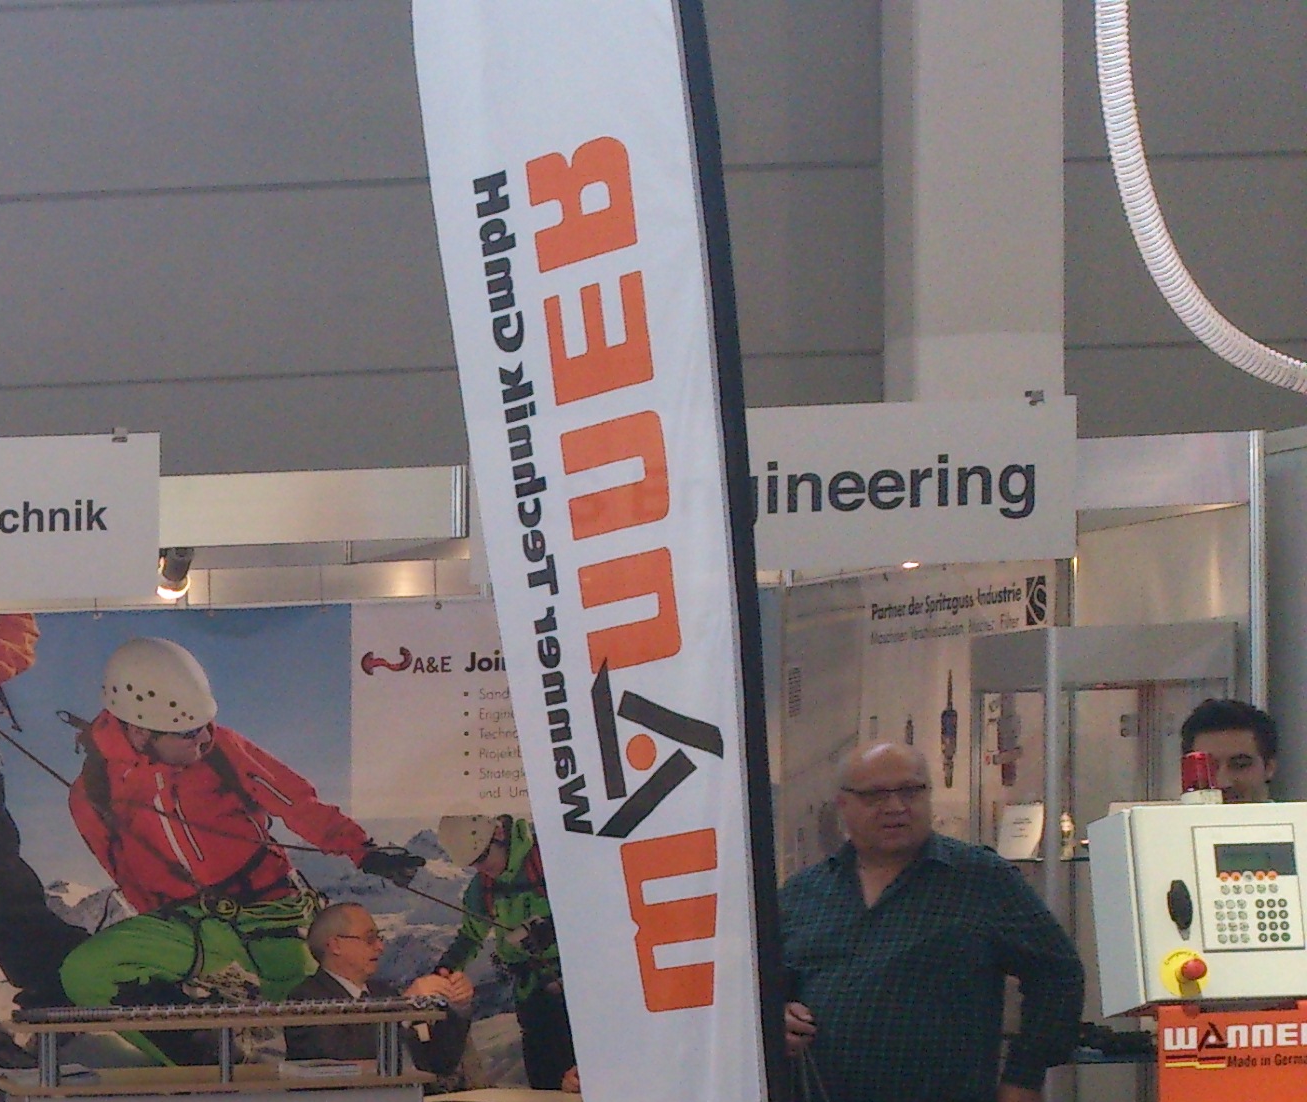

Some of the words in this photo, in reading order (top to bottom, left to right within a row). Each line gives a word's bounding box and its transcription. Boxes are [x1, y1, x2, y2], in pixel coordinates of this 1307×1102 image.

[749, 454, 1035, 519] ineering
[413, 656, 452, 674] A&E
[1227, 1054, 1258, 1068] Made
[1260, 1054, 1271, 1066] in
